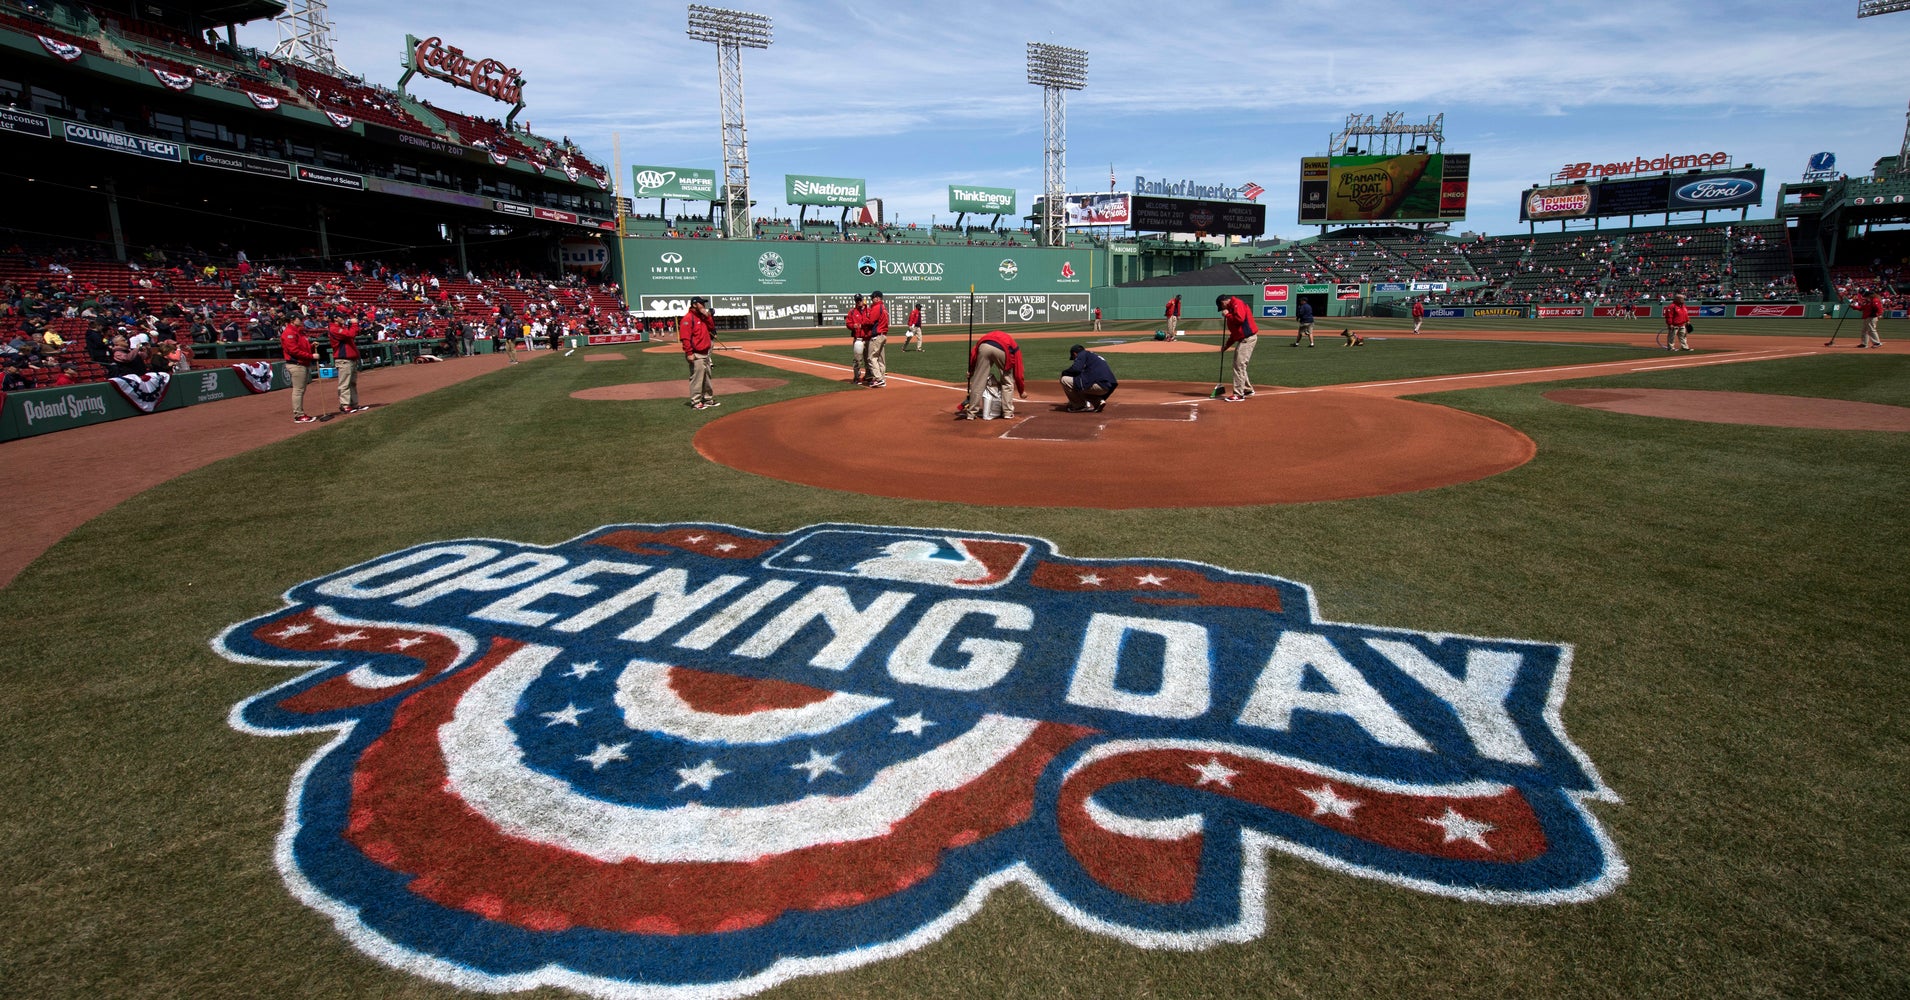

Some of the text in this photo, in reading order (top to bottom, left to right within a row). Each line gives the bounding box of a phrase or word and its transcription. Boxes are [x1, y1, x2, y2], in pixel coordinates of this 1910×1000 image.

[416, 36, 522, 104] Coca-Cola
[1330, 110, 1445, 153] John Hancock
[66, 125, 174, 156] COLUMBIA TECH
[399, 134, 462, 156] OPENING DAY 2017
[205, 155, 242, 168] Barracuda
[1592, 160, 1634, 178] new
[1635, 151, 1727, 173] balance
[308, 172, 332, 181] Museum
[339, 178, 360, 187] Science
[640, 171, 661, 187] AAA
[1341, 173, 1388, 185] BANANA
[809, 182, 849, 196] National
[1135, 176, 1238, 200] Bank of America
[1351, 183, 1379, 198] BOAT
[1691, 181, 1741, 199] Ford
[953, 189, 1011, 205] ThinkEnergy
[1546, 194, 1588, 205] DUNKIN'
[1545, 202, 1584, 211] DONUTS
[879, 259, 945, 275] FOXWOODS
[1023, 296, 1046, 304] WEBB
[1059, 304, 1087, 312] OPTUM
[1429, 309, 1455, 318] jetBlue
[1474, 308, 1521, 316] GRANITE CITY
[207, 391, 224, 401] balance
[23, 393, 107, 426] Poland Spring
[315, 544, 1540, 767] OPENING DAY
